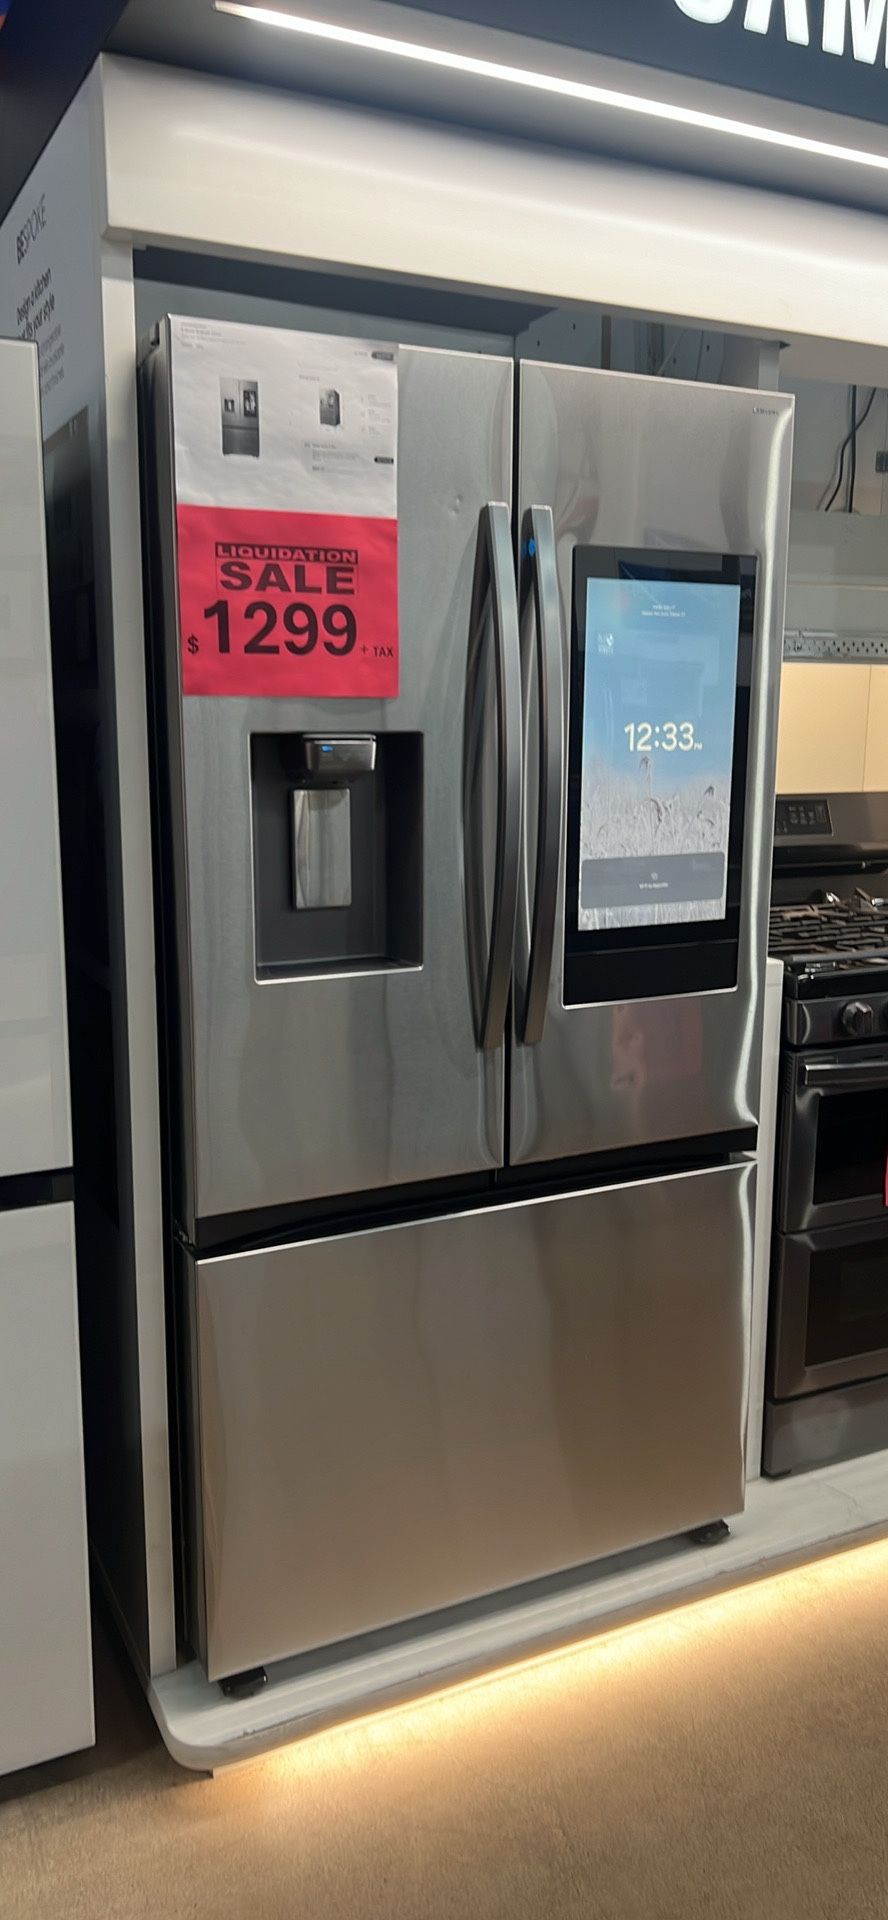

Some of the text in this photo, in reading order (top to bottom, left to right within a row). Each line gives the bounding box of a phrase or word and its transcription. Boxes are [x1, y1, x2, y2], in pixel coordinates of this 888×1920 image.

[16, 192, 47, 265] BESPOKE
[216, 543, 358, 563] LIQUIDATION
[220, 561, 355, 595] SALE
[187, 634, 199, 655] $
[204, 599, 357, 656] 1299
[373, 646, 394, 657] TAX
[624, 722, 694, 752] 12:33
